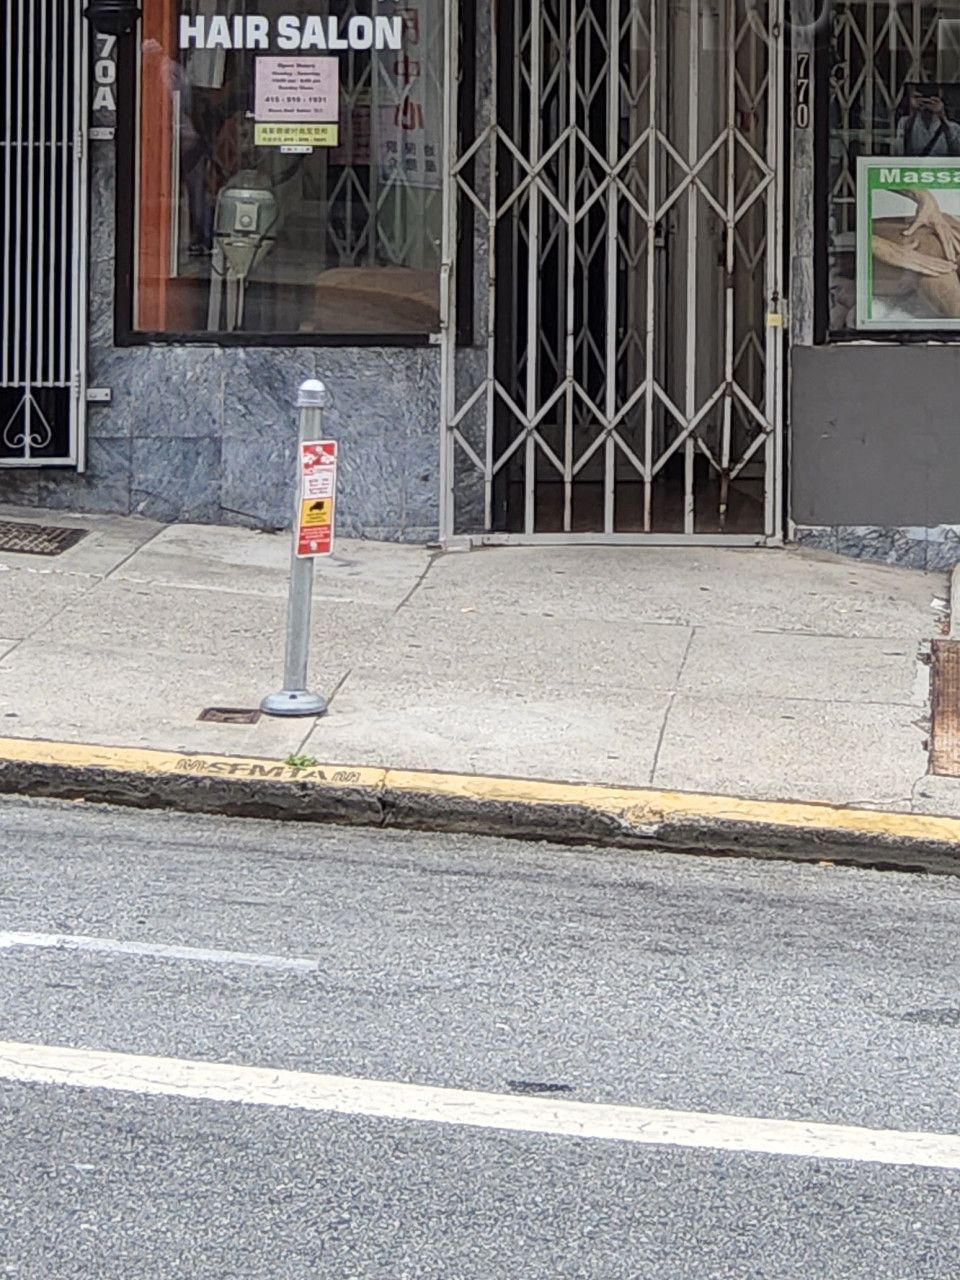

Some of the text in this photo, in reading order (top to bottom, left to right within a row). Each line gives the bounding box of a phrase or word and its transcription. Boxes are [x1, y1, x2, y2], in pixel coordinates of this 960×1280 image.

[179, 15, 403, 51] HAIR SALON
[796, 53, 810, 129] 770
